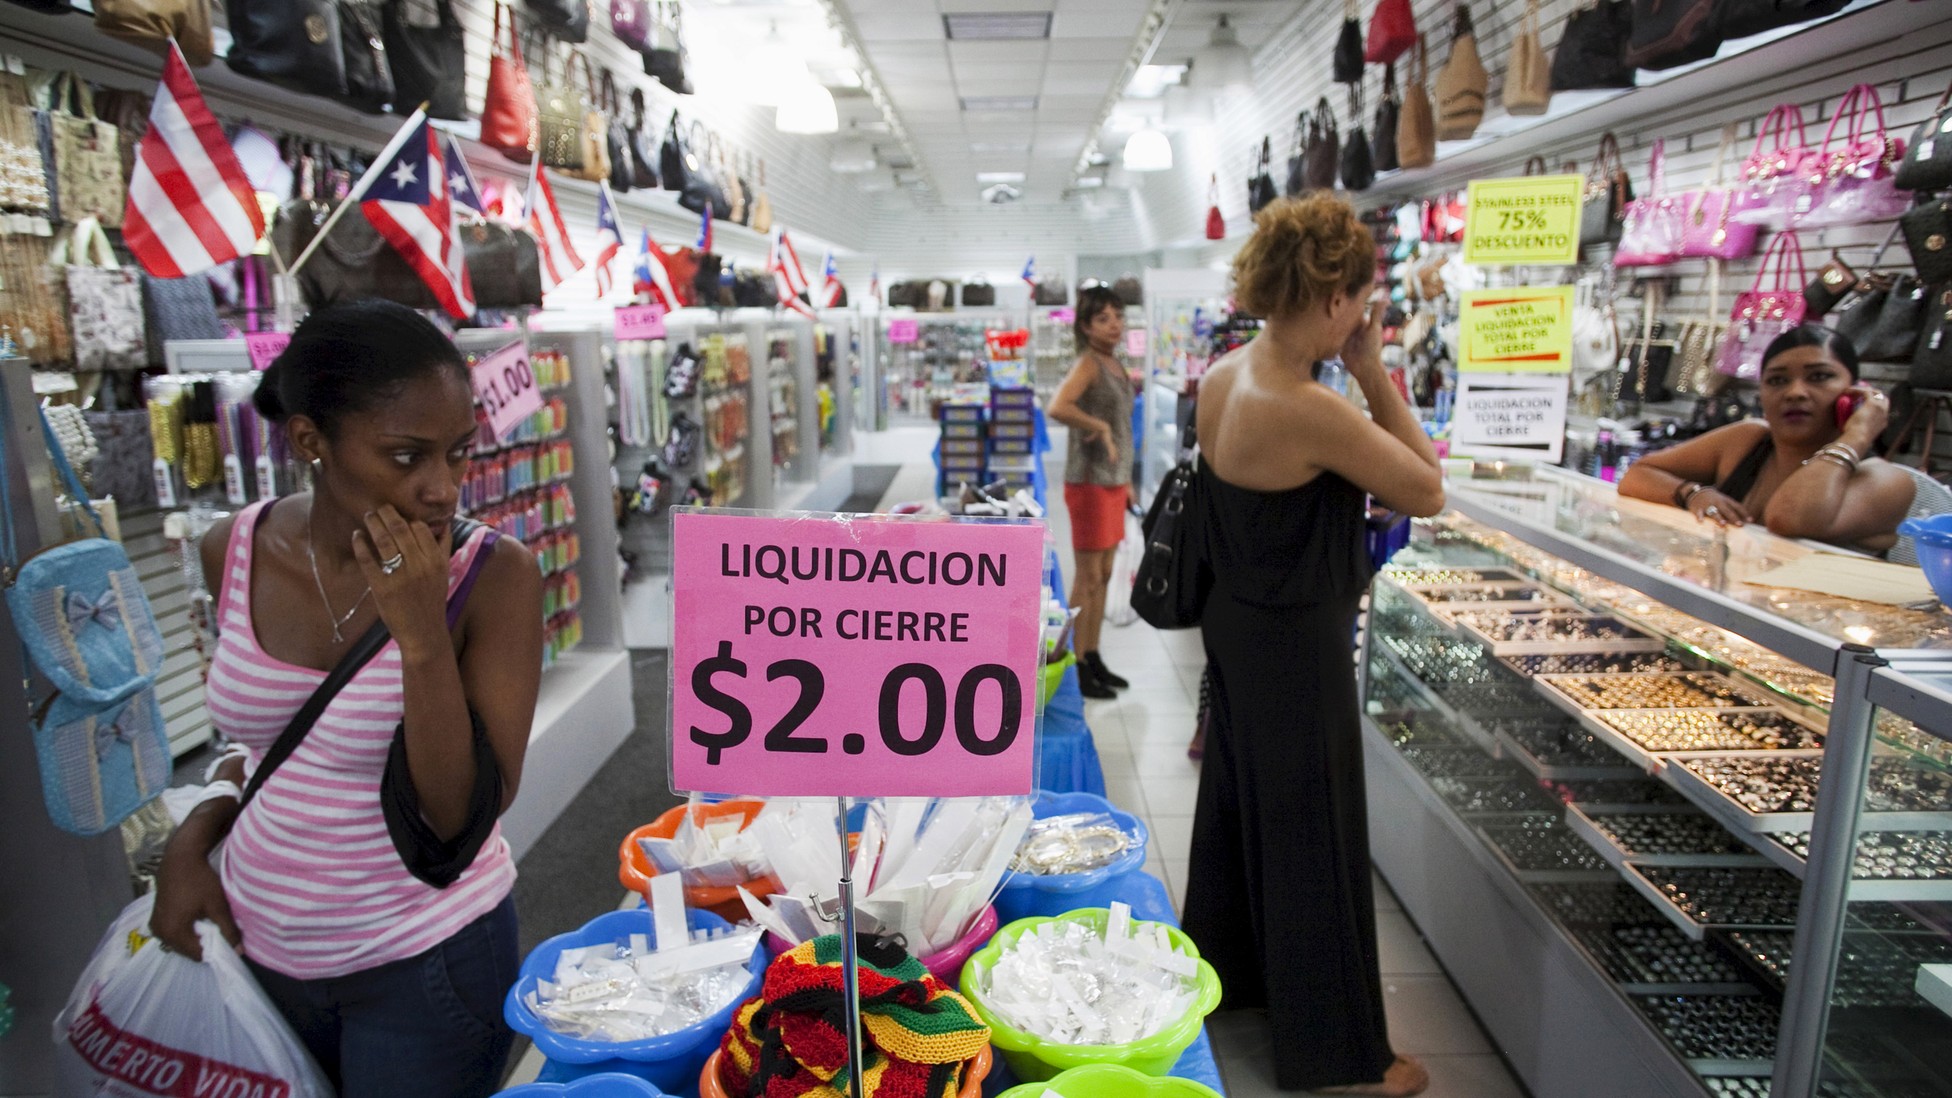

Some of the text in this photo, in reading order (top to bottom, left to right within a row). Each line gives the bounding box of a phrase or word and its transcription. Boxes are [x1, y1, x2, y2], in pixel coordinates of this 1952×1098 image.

[1475, 194, 1575, 208] STAINLESS STEEL
[1498, 210, 1547, 230] 75%
[1474, 234, 1568, 250] DESCUENTO
[1494, 304, 1535, 317] VENTA
[1475, 315, 1556, 332] LIQUIDACION
[1484, 329, 1549, 344] TOTAL POR
[1495, 341, 1536, 355] CIERRE
[481, 360, 531, 417] $1.00
[1467, 398, 1553, 411] LIQUIDACION
[1475, 411, 1544, 424] TOTAL POR
[1486, 425, 1529, 437] CIERRE
[721, 542, 1007, 587] LIQUIDACION
[744, 605, 970, 643] POR CIERRE
[689, 640, 1022, 766] $2.00
[71, 1012, 185, 1091] UMERTO
